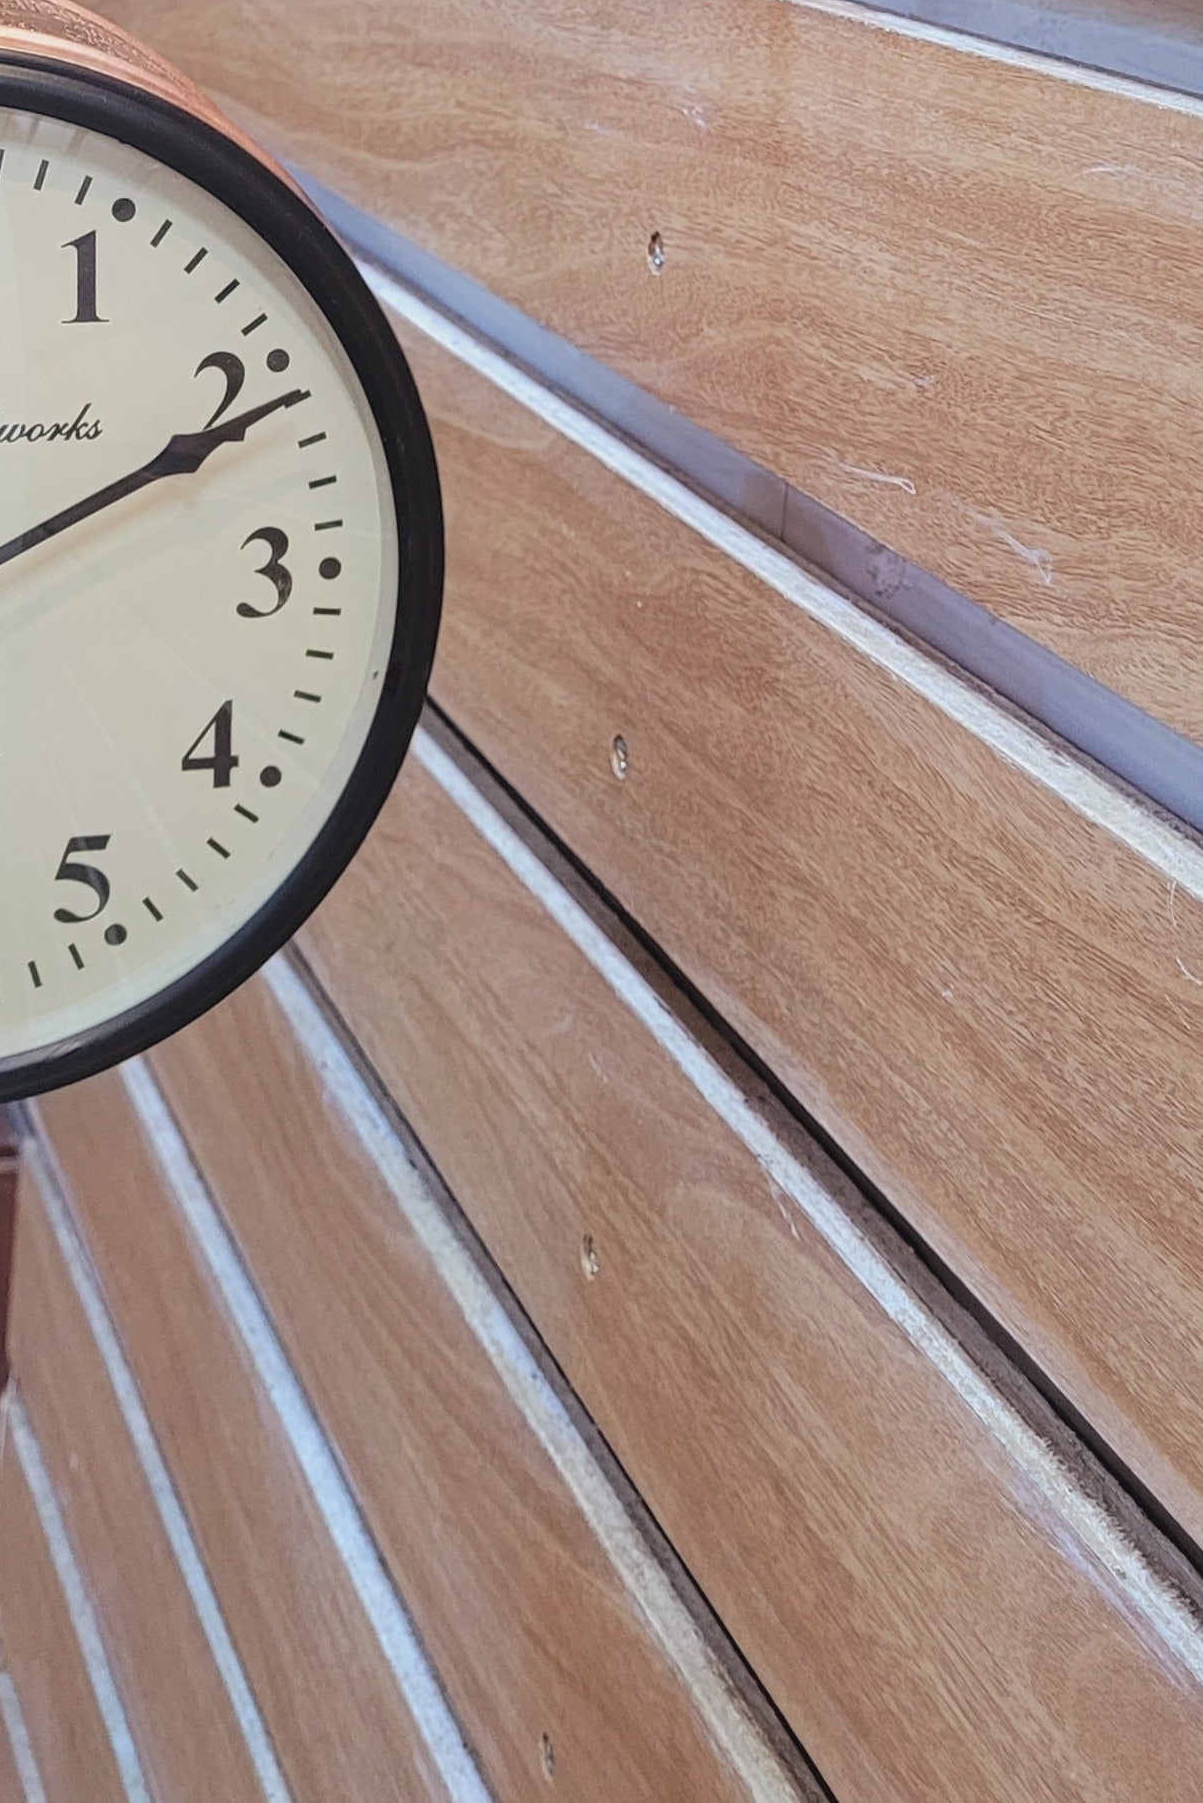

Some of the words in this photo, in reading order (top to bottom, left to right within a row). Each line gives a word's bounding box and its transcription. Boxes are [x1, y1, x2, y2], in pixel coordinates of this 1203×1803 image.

[61, 229, 110, 324] 1
[194, 351, 246, 442] 2
[236, 526, 293, 619] 3
[181, 700, 240, 789] 4
[53, 835, 112, 924] 5
